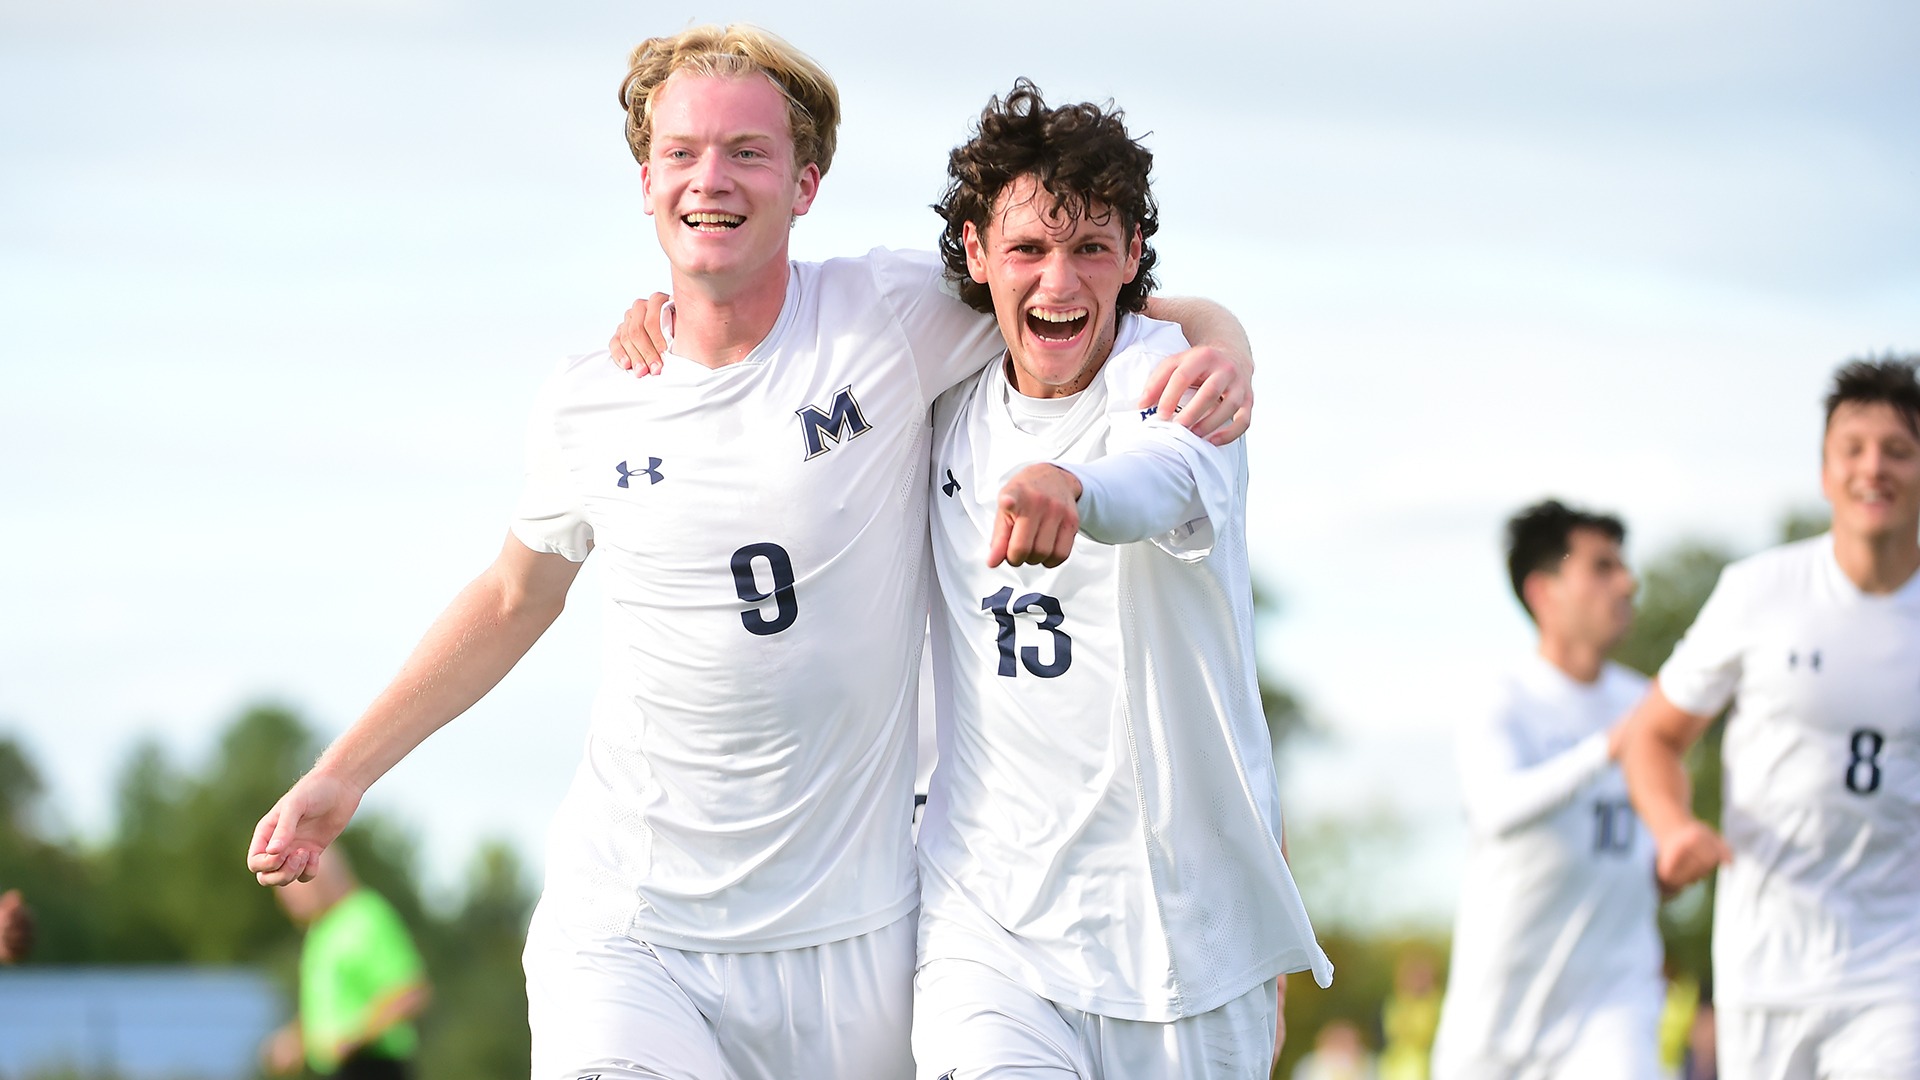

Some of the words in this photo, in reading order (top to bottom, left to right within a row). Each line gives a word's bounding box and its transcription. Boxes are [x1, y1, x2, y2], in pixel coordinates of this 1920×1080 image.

[795, 384, 873, 462] M
[730, 542, 798, 636] 9
[981, 586, 1072, 679] 13
[1845, 729, 1884, 795] 8
[1593, 802, 1636, 856] 10
